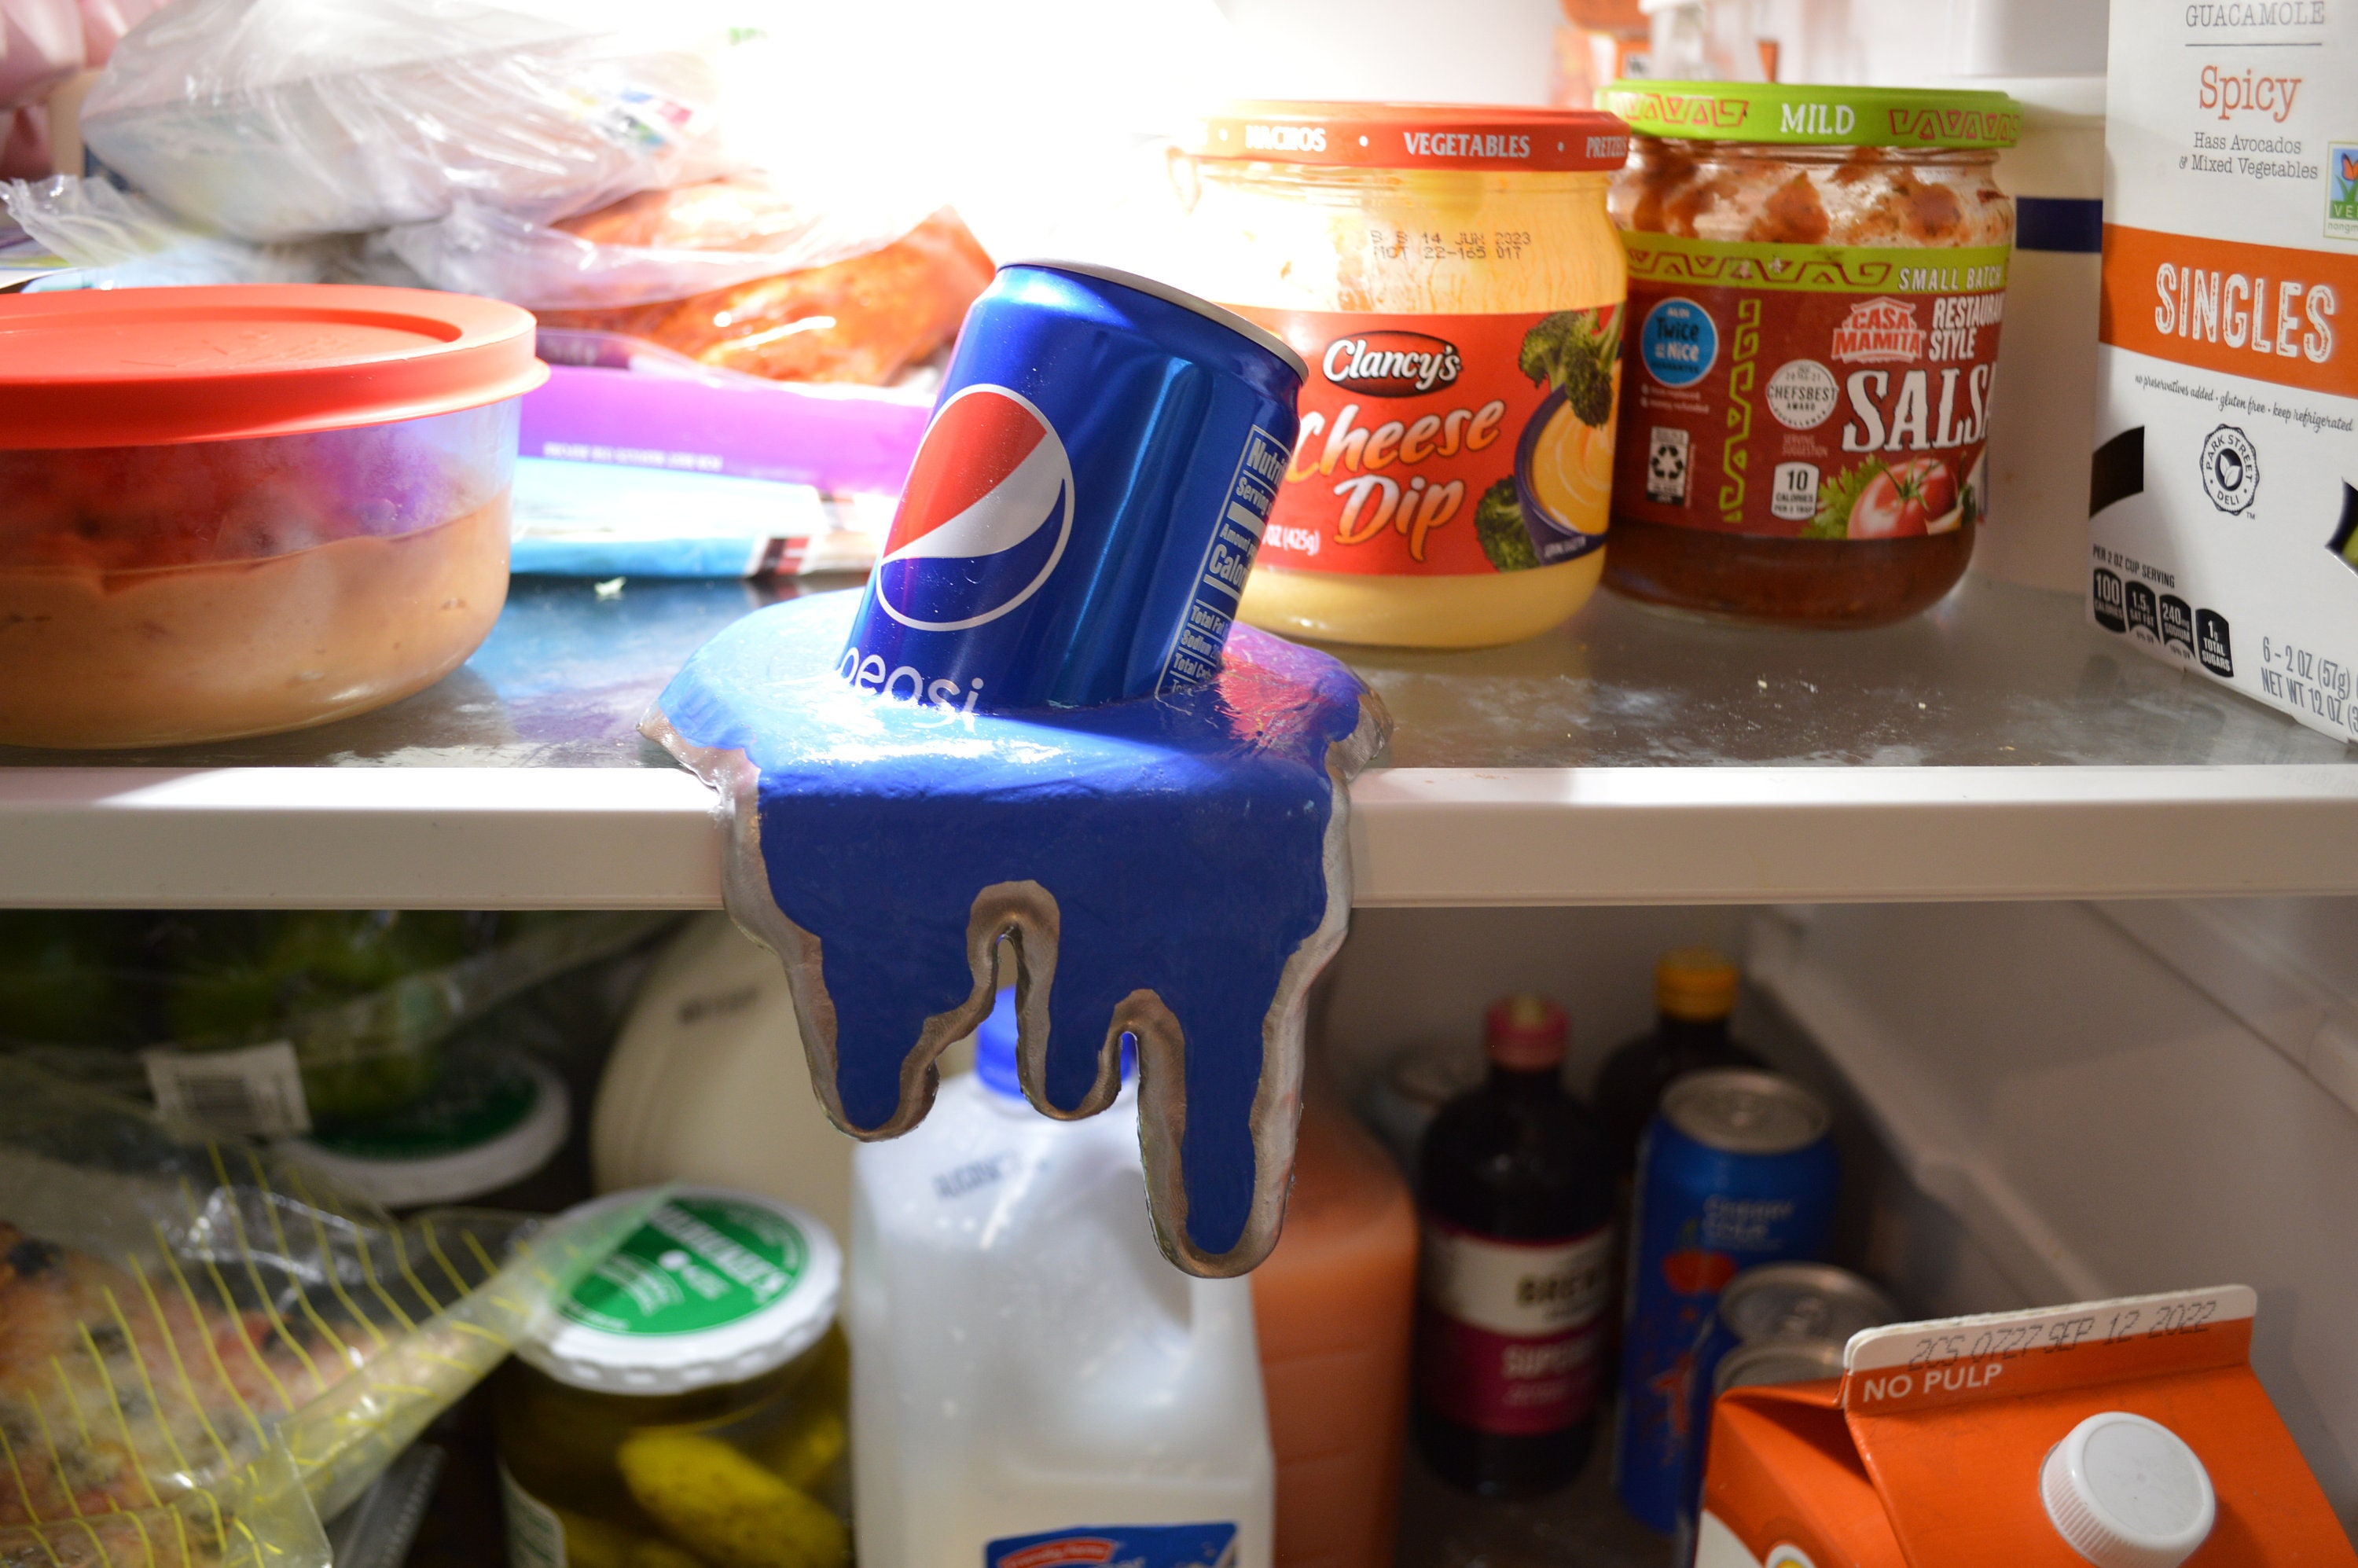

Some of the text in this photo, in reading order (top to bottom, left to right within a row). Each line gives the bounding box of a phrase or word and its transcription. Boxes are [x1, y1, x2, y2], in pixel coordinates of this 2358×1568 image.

[2185, 1, 2325, 28] GUACAMOLE
[2199, 64, 2301, 123] Spicy
[1780, 103, 1856, 135] MILD
[1245, 125, 1327, 152] NACHOS
[1404, 132, 1531, 159] VEGETABLES
[2193, 131, 2301, 155] Hass Avocados
[2179, 155, 2319, 180] & Mixed Vegetables
[2334, 204, 2358, 219] VE
[1421, 231, 1442, 244] 14
[1454, 231, 1486, 245] JUN
[1494, 231, 1532, 245] 2023
[1898, 263, 2002, 292] SMALL BATCH
[1850, 310, 1908, 331] CASA
[2154, 262, 2336, 364] SINGLES
[1657, 317, 1700, 342] Twice
[1929, 326, 1978, 362] STYLE
[1667, 341, 1700, 362] Nice
[1832, 331, 1922, 358] MAMITA
[1323, 339, 1460, 391] Clancy's
[1766, 385, 1838, 402] CHEFSBEST
[2143, 374, 2190, 398] preservatives
[2190, 384, 2215, 402] added
[2219, 389, 2247, 413] gluten
[2247, 398, 2267, 416] free
[2272, 402, 2292, 425] keep
[2292, 409, 2355, 434] refrigerated
[1285, 399, 1507, 483] Cheese
[2206, 434, 2253, 483] PARK STREET
[1786, 468, 1809, 492] 10
[1236, 476, 1269, 516] Serving
[2217, 490, 2240, 505] DELI
[1334, 473, 1466, 563] Dip
[1219, 523, 1251, 552] Amount
[1282, 527, 1320, 556] (425g)
[2092, 543, 2176, 589] PER 2 OZ CUP SERVING
[2095, 573, 2121, 604] 100
[1190, 604, 1214, 630] Total
[1213, 617, 1225, 635] Fat
[2164, 622, 2191, 643] SODIUM
[2207, 619, 2219, 641] 1g
[1181, 629, 1213, 657] Sodium
[2203, 637, 2226, 656] TOTAL
[1172, 652, 1197, 677] Total
[2202, 651, 2231, 672] SUGARS
[2262, 635, 2271, 663] 6
[2285, 644, 2294, 673] 2
[2297, 649, 2313, 681] OZ
[2317, 657, 2350, 700] (57g)
[2261, 666, 2283, 699] NET
[2286, 677, 2305, 708] WT
[2308, 686, 2325, 718] 12
[2327, 695, 2344, 726] OZ
[1972, 1324, 2044, 1364] 0727
[2045, 1316, 2095, 1353] SEP
[2103, 1309, 2142, 1346] 12
[2147, 1299, 2217, 1340] 2022
[1863, 1364, 2004, 1402] NO PULP
